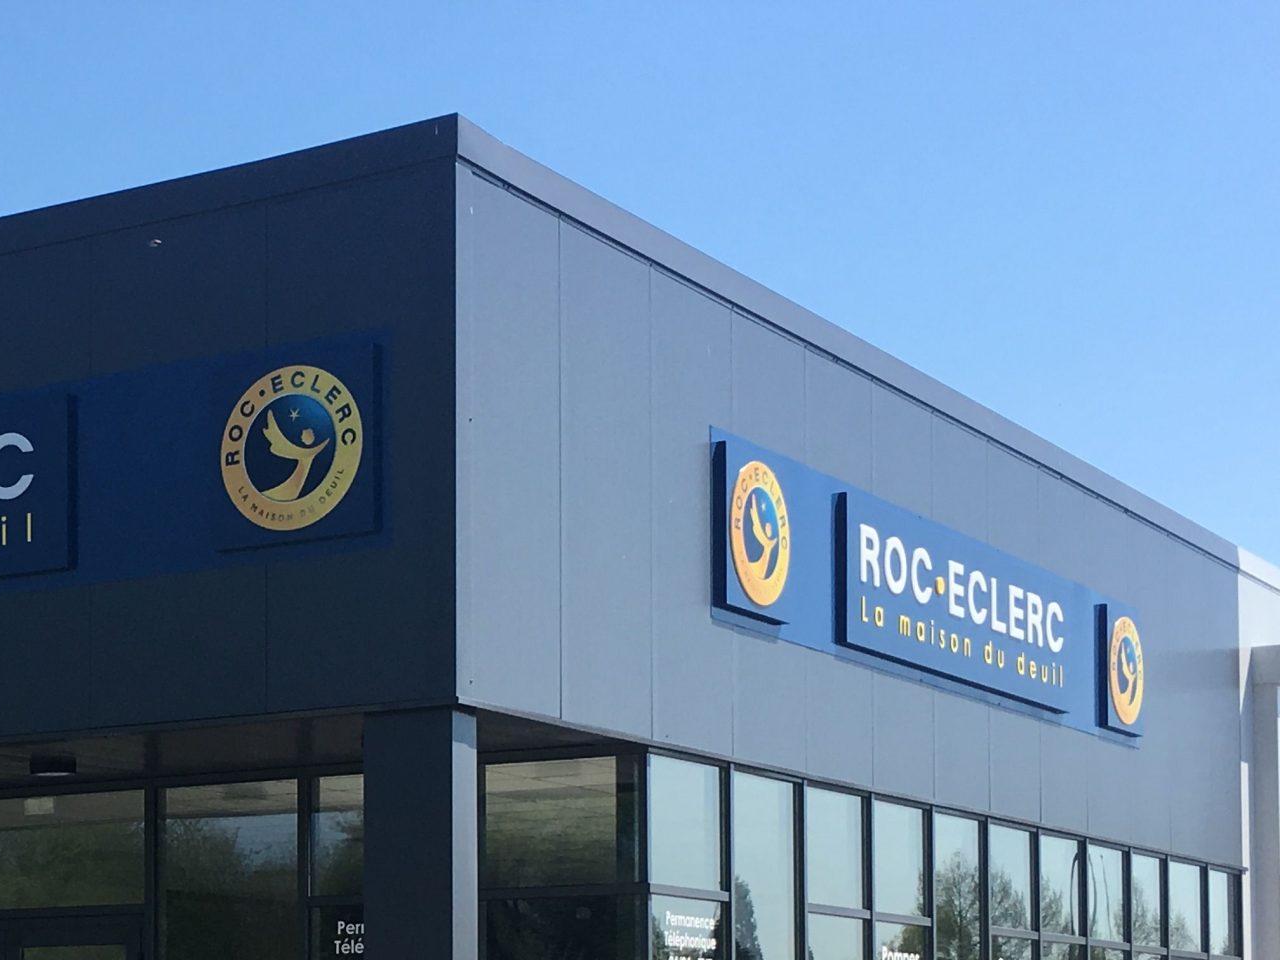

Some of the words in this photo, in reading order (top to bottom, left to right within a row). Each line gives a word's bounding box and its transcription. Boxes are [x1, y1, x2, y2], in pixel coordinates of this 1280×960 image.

[861, 596, 884, 627] La
[899, 615, 971, 657] maison
[984, 640, 1005, 668] du
[1017, 652, 1063, 688] deuil
[666, 911, 715, 930] Permanence
[664, 930, 717, 952] Téléphonique
